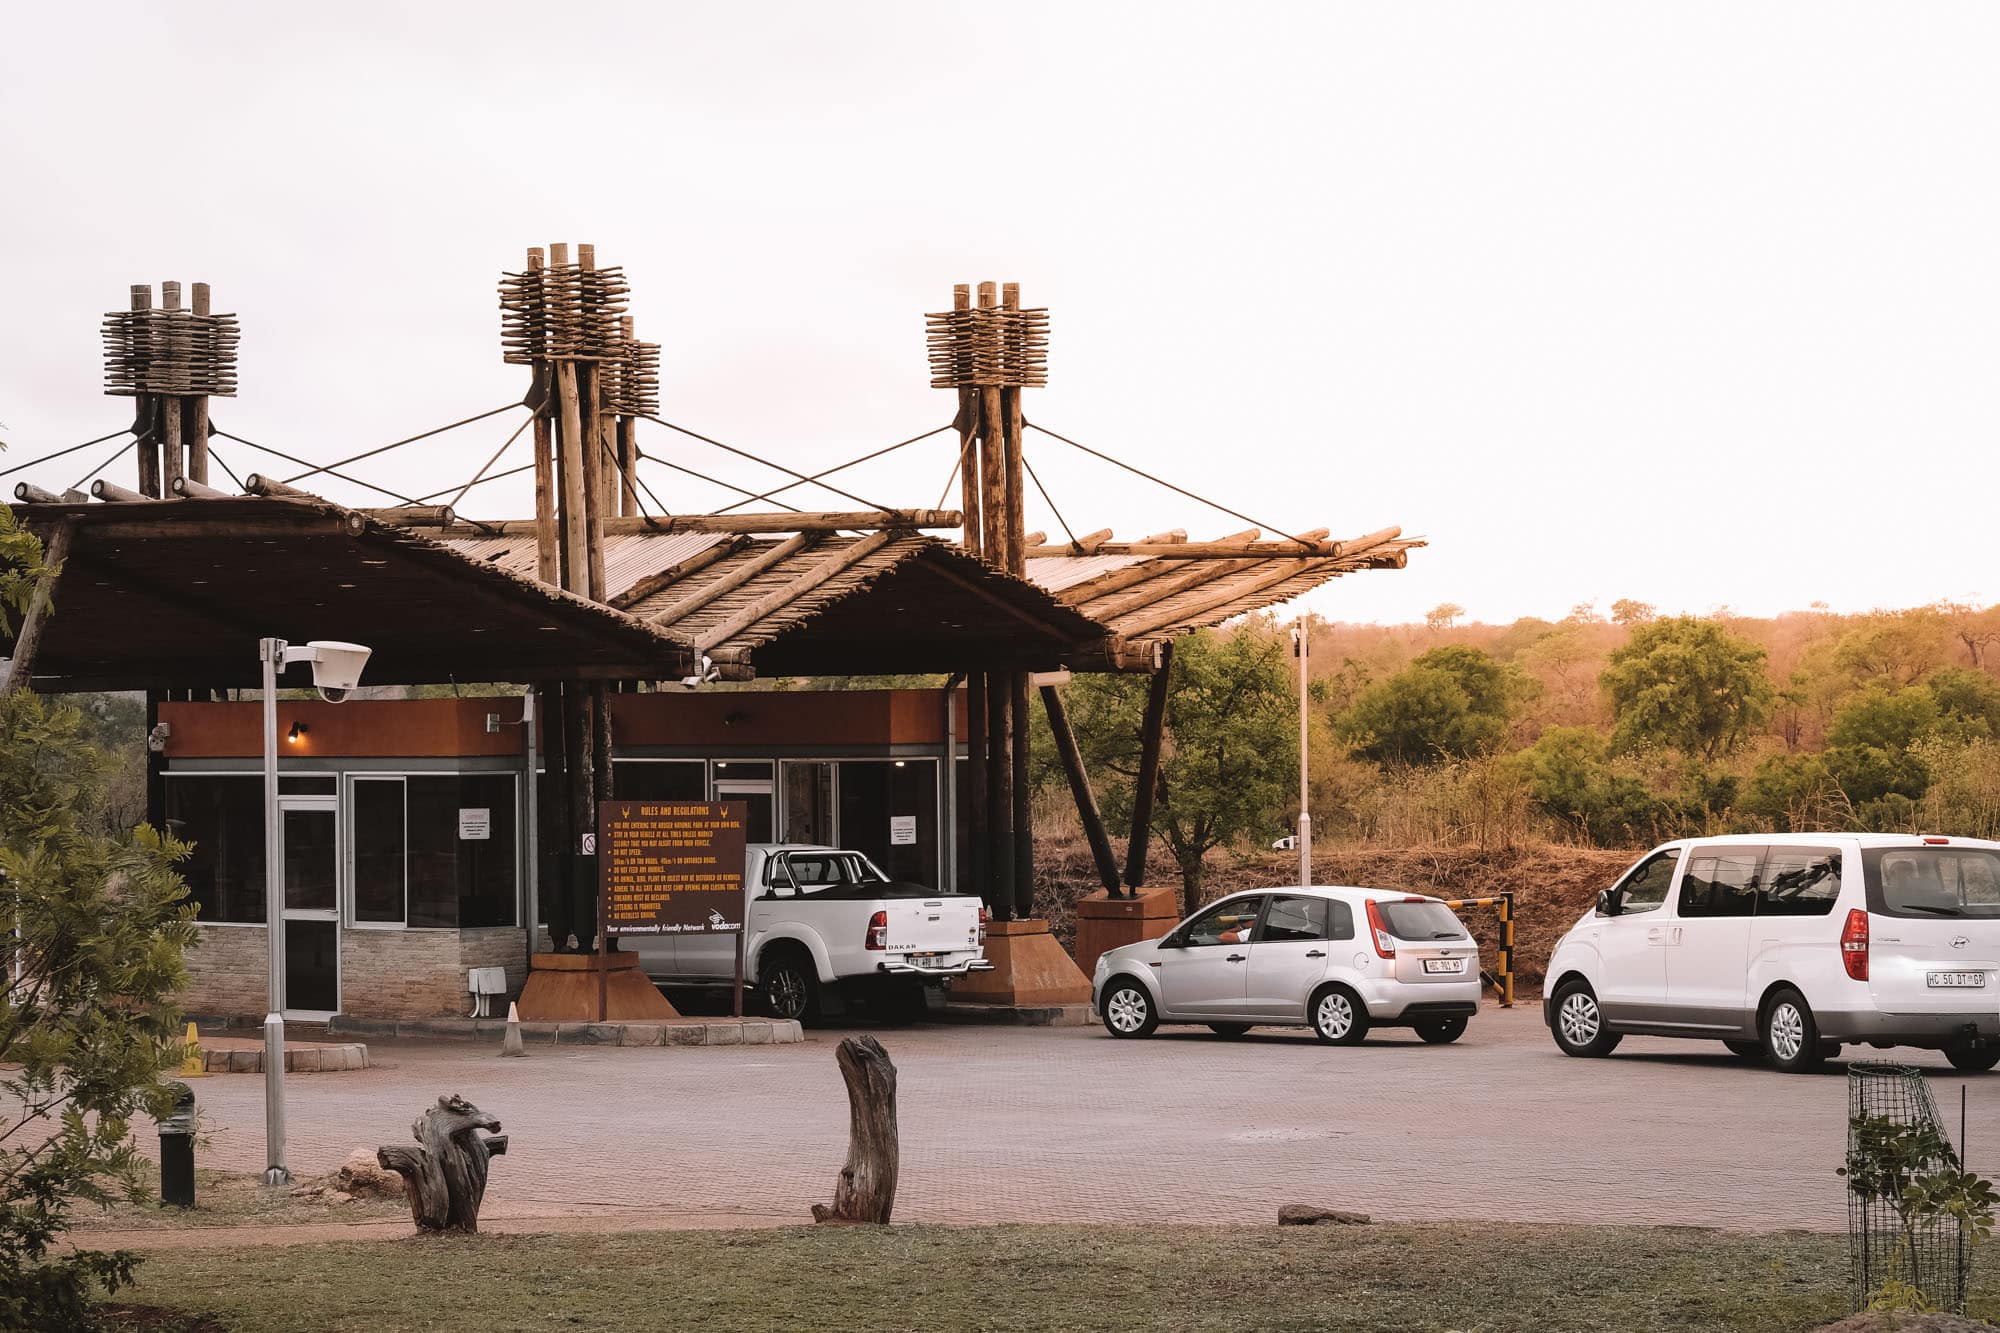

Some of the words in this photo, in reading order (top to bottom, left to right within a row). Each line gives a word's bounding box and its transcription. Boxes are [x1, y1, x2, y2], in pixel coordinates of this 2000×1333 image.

[640, 806, 658, 816] RULES
[660, 806, 672, 816] AND
[673, 806, 709, 816] REGULATIONS
[620, 924, 661, 932] environmentally
[662, 923, 681, 932] friendly
[683, 923, 705, 931] Network
[712, 921, 741, 930] vodacom
[1929, 974, 1939, 984] HC
[1944, 974, 1953, 984] 50
[1958, 975, 1966, 984] DT
[1974, 974, 1983, 984] GP
